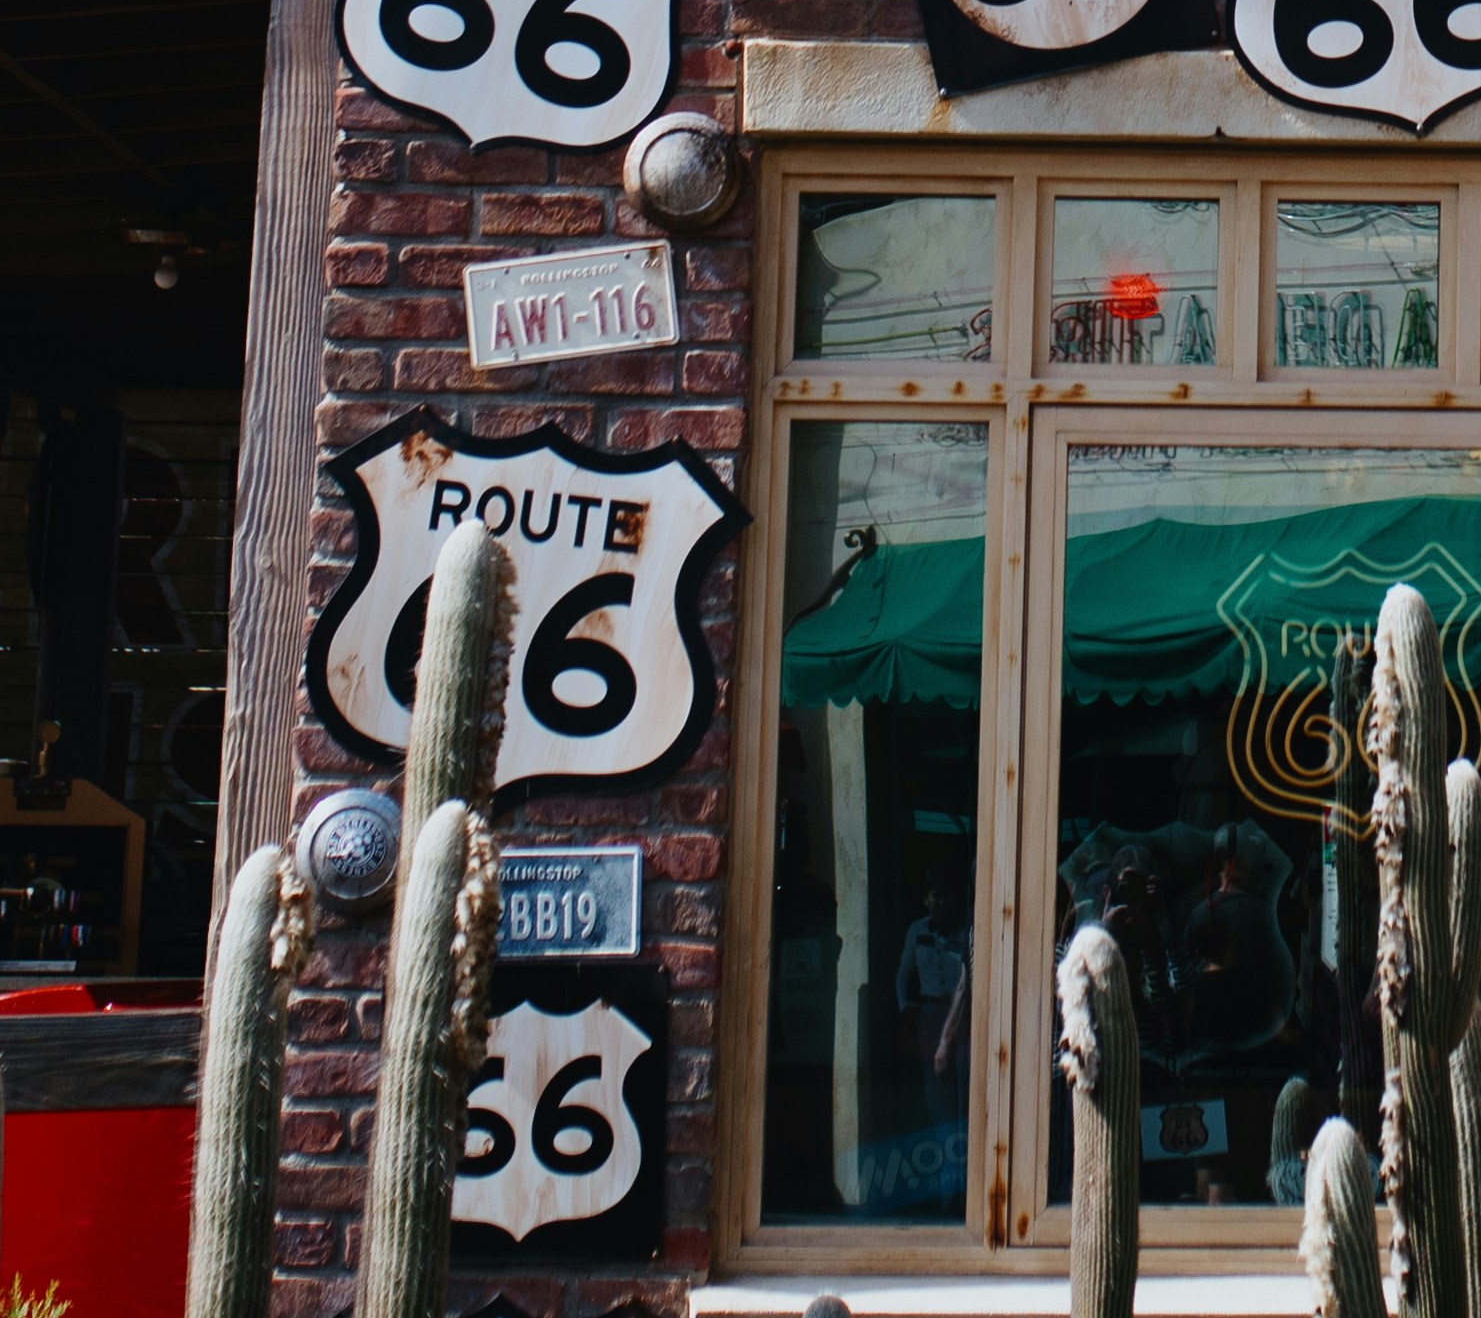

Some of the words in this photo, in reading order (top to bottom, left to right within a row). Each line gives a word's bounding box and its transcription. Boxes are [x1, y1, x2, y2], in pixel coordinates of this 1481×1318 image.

[490, 280, 656, 351] AW1-116
[427, 478, 645, 556] ROUTE
[1281, 617, 1372, 660] ROU
[499, 866, 584, 882] OLLINGSTOP
